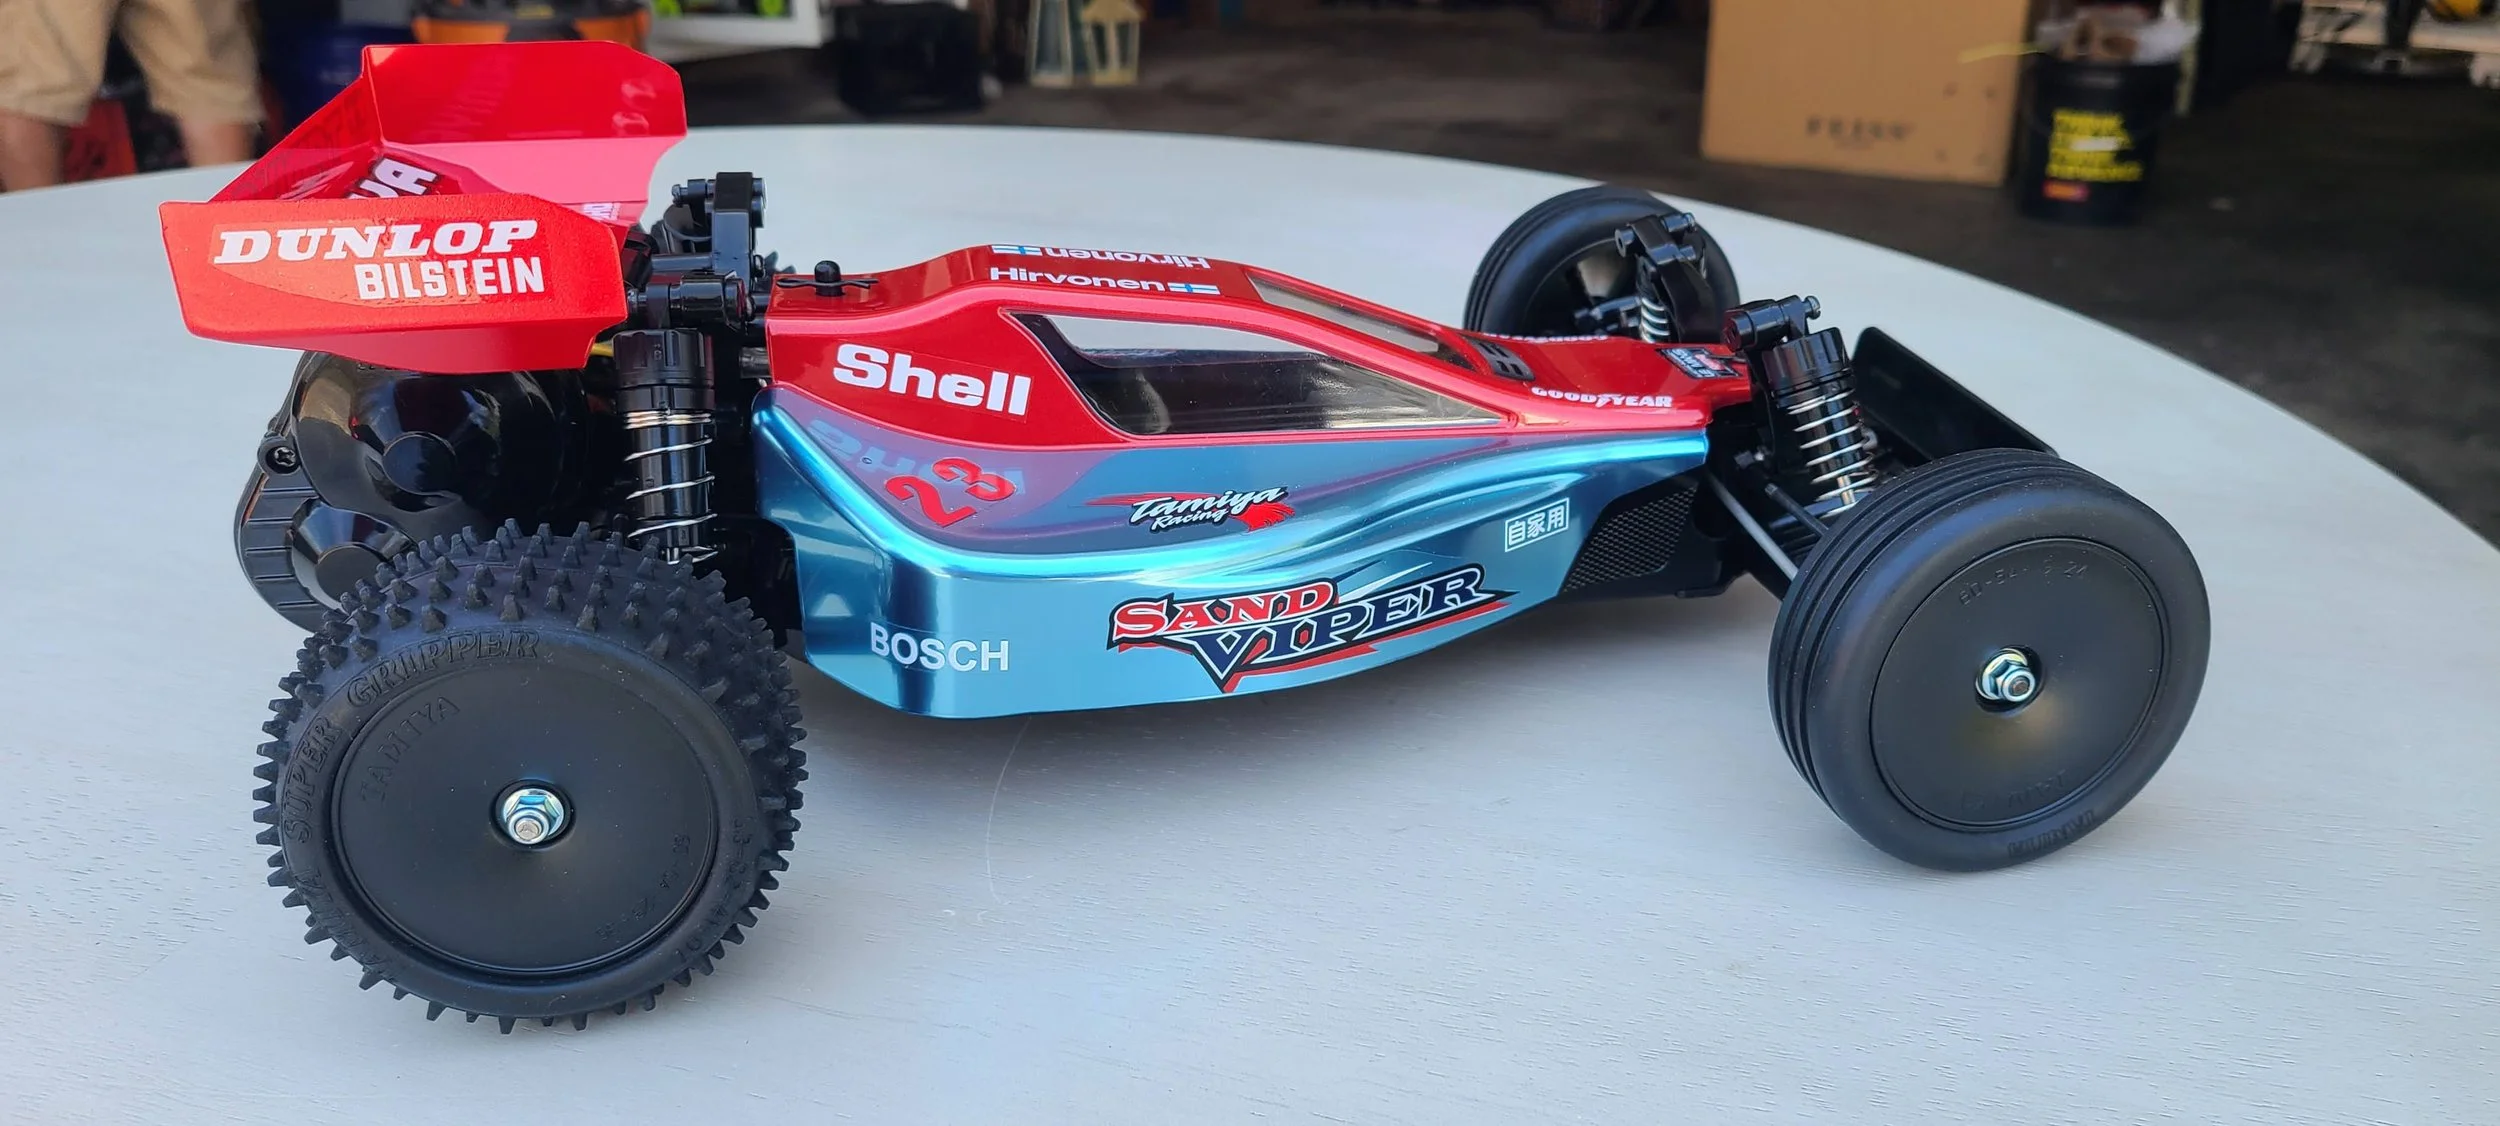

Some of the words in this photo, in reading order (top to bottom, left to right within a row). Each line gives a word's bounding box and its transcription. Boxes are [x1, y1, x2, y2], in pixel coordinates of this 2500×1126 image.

[214, 219, 538, 264] DUNLOP
[1043, 246, 1210, 269] Hirvonen
[354, 256, 544, 300] BILSTEIN
[989, 266, 1165, 292] Hirvonen
[833, 343, 1032, 416] Shell
[1531, 386, 1673, 408] GOODYEAR
[884, 456, 1017, 528] 23
[1132, 486, 1286, 521] Tamiya
[1152, 507, 1229, 531] Racing
[1507, 505, 1567, 544] 自家用
[1113, 580, 1338, 639] SAND
[1182, 566, 1497, 679] VIPER
[870, 622, 1009, 672] BOSCH
[282, 715, 345, 844] SUPER
[346, 629, 541, 708] GRIPPER
[360, 695, 461, 804] TAMIYA
